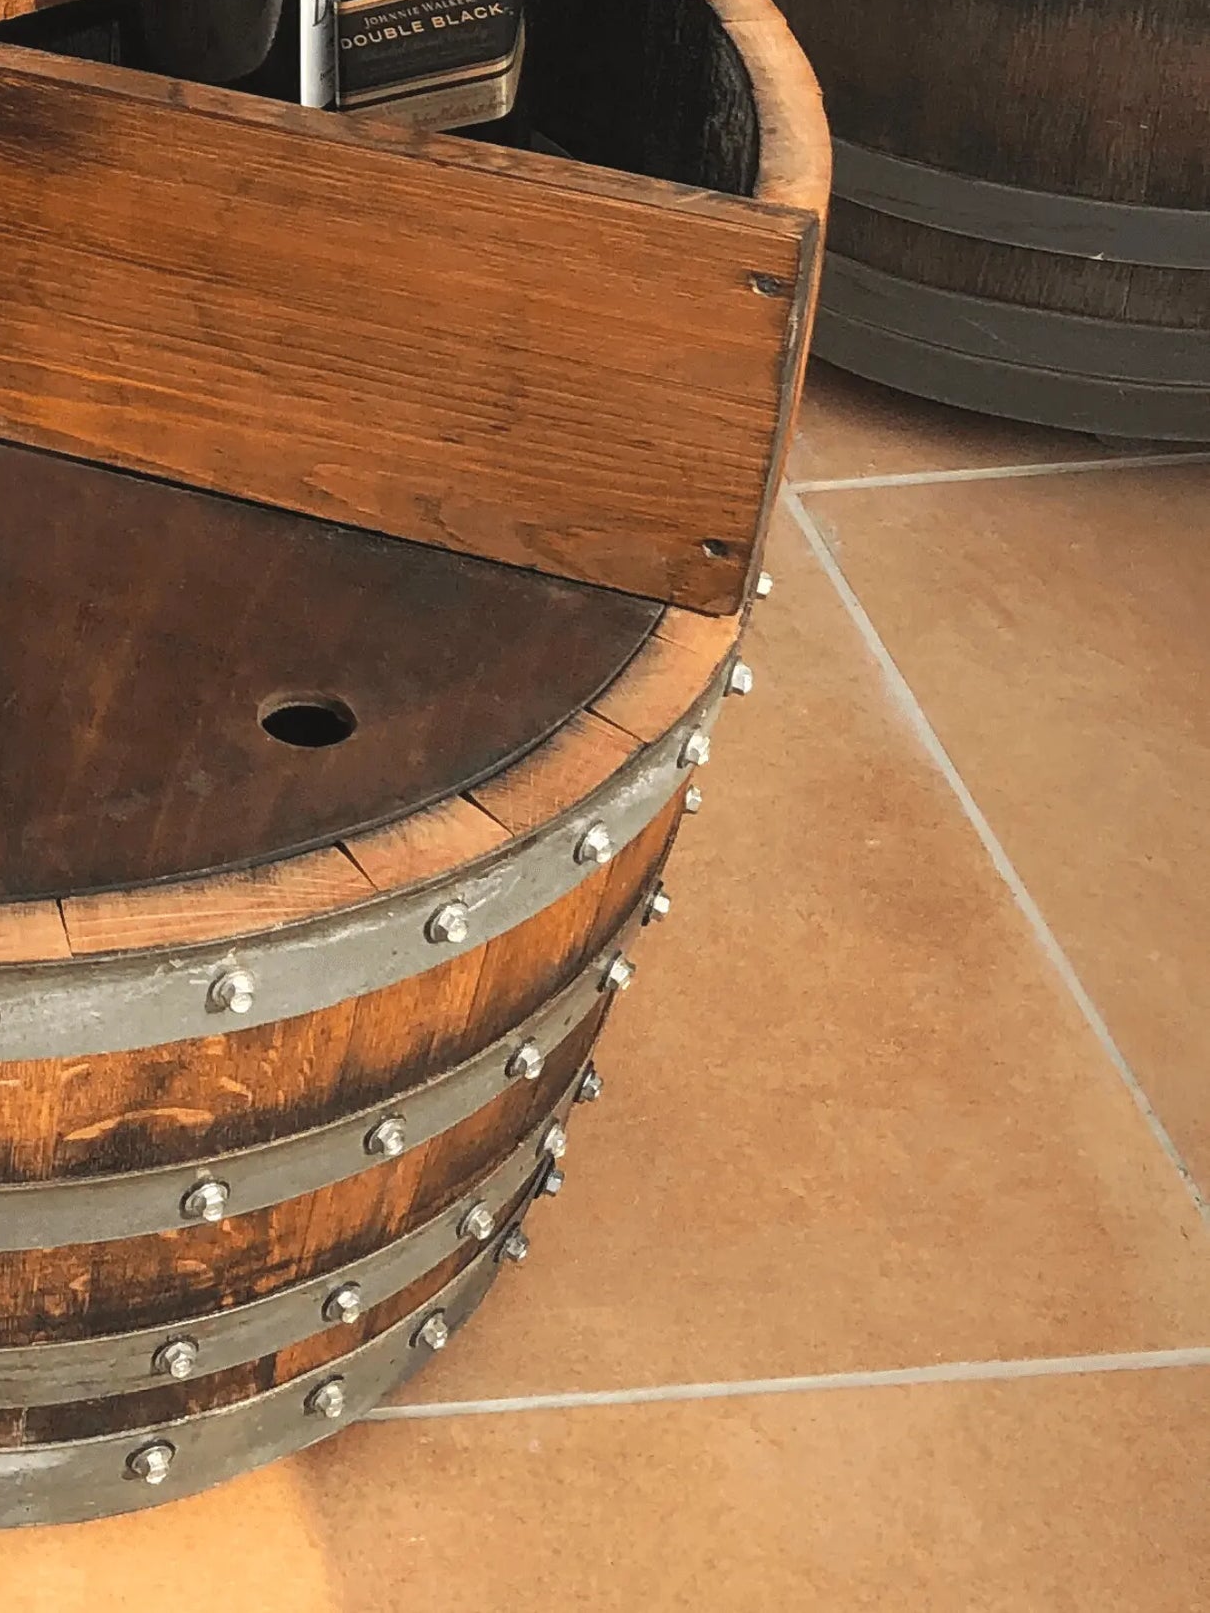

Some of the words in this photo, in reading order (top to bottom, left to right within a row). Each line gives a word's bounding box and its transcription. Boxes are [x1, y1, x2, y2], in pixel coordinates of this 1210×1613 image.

[341, 19, 424, 50] DOUBLE
[431, 2, 504, 29] BLACK
[363, 1, 421, 30] JOHNNIE
